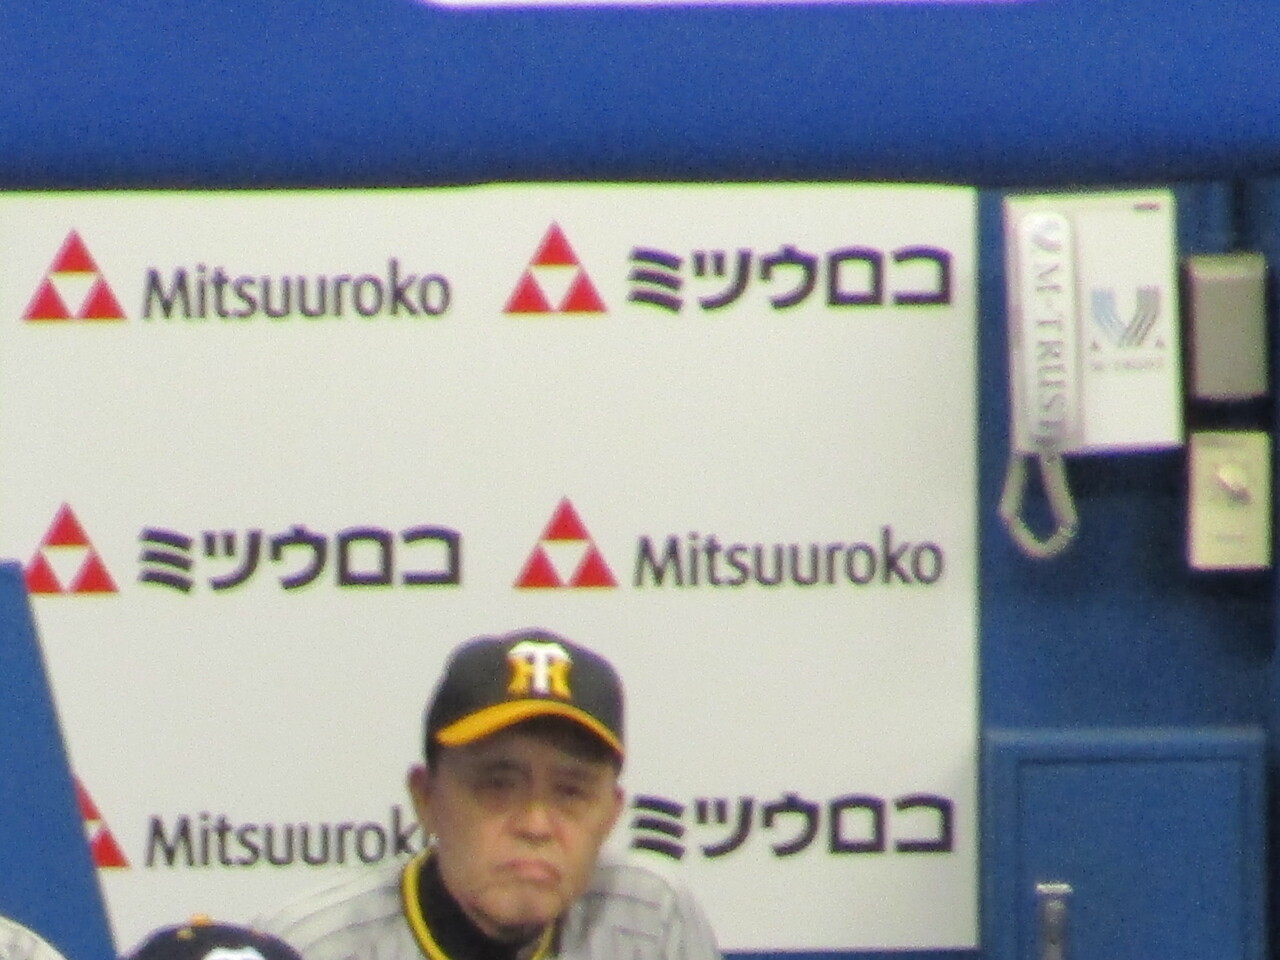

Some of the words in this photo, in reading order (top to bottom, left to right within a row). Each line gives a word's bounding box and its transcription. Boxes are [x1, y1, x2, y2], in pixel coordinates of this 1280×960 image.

[141, 257, 451, 321] Mitsuuroko
[627, 245, 954, 313] ミツウロコ
[137, 524, 463, 593] ミツウロコ
[633, 525, 945, 588] Mitsuuroko
[145, 806, 429, 868] Mitsuurok
[630, 792, 954, 861] ミツウロコ
